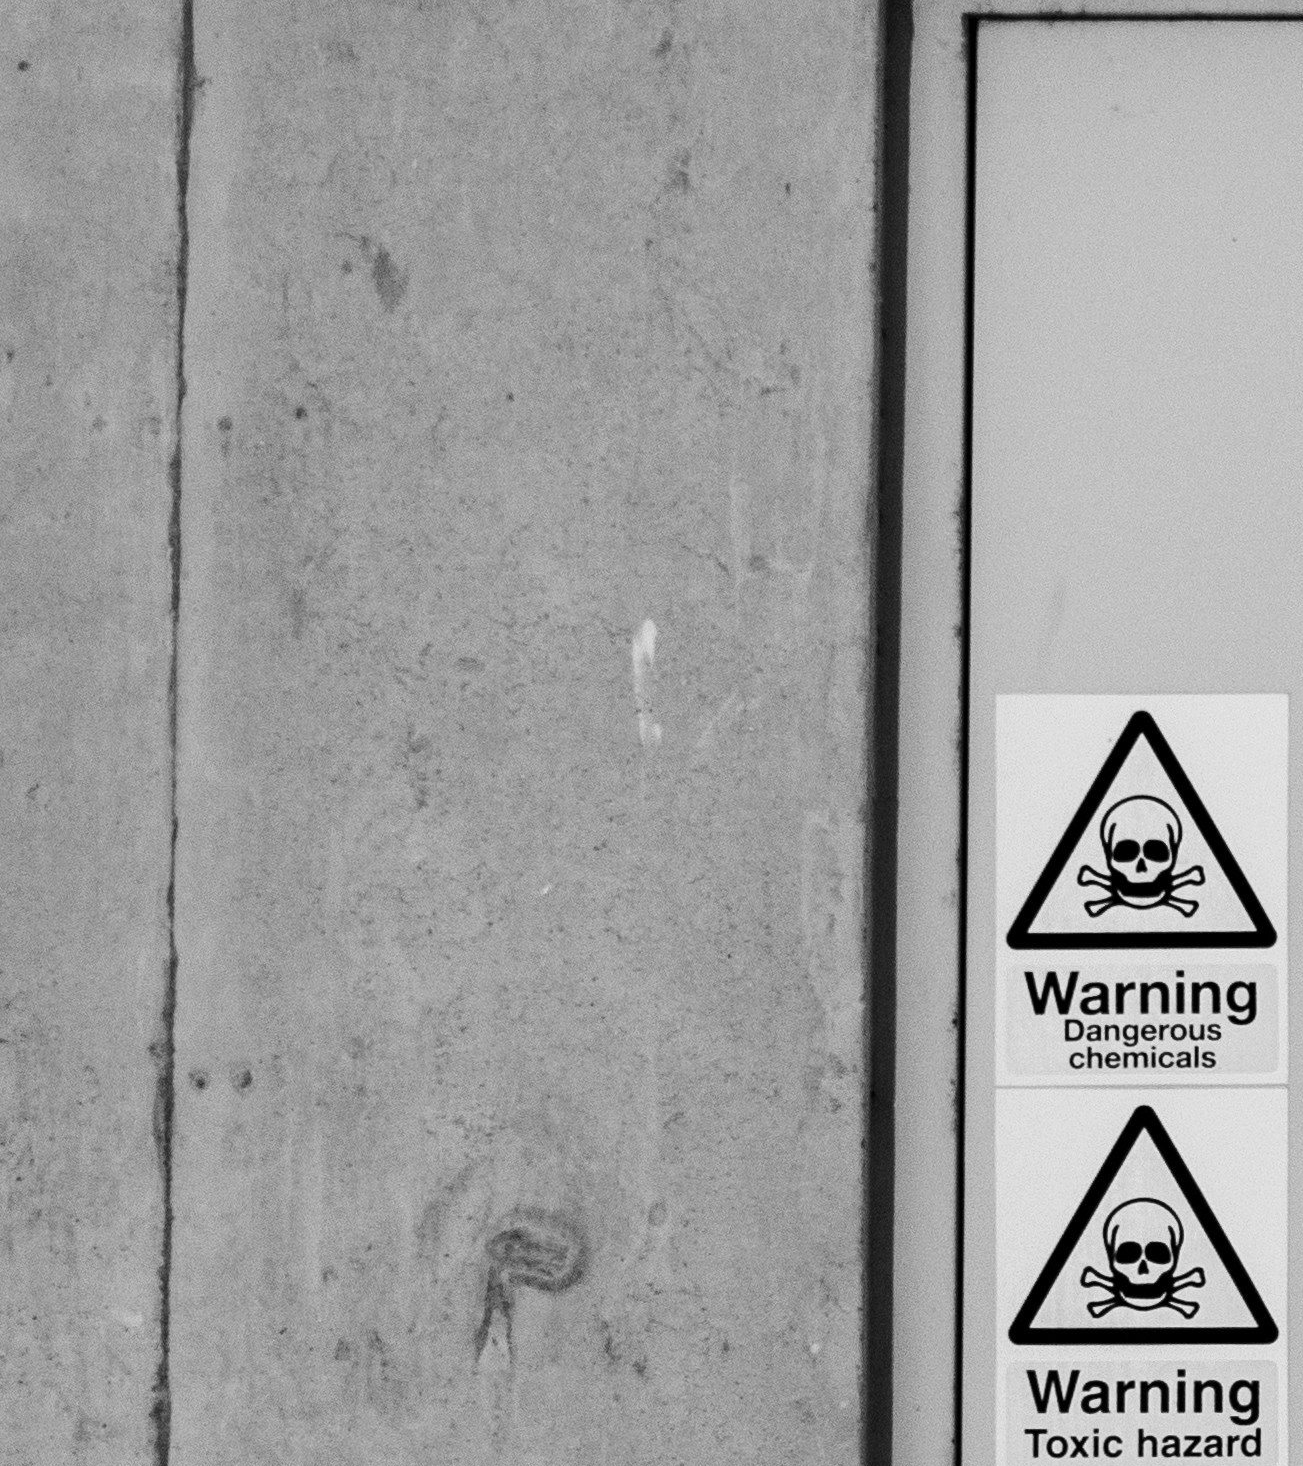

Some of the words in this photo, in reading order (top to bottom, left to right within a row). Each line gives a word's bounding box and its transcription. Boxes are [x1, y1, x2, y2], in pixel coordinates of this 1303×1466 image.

[1024, 970, 1257, 1025] Warning
[1064, 1019, 1222, 1047] Dangerous
[1069, 1046, 1217, 1069] chemicals
[1026, 1368, 1260, 1425] Warning
[1024, 1427, 1123, 1459] Toxic
[1137, 1427, 1262, 1459] hazard
